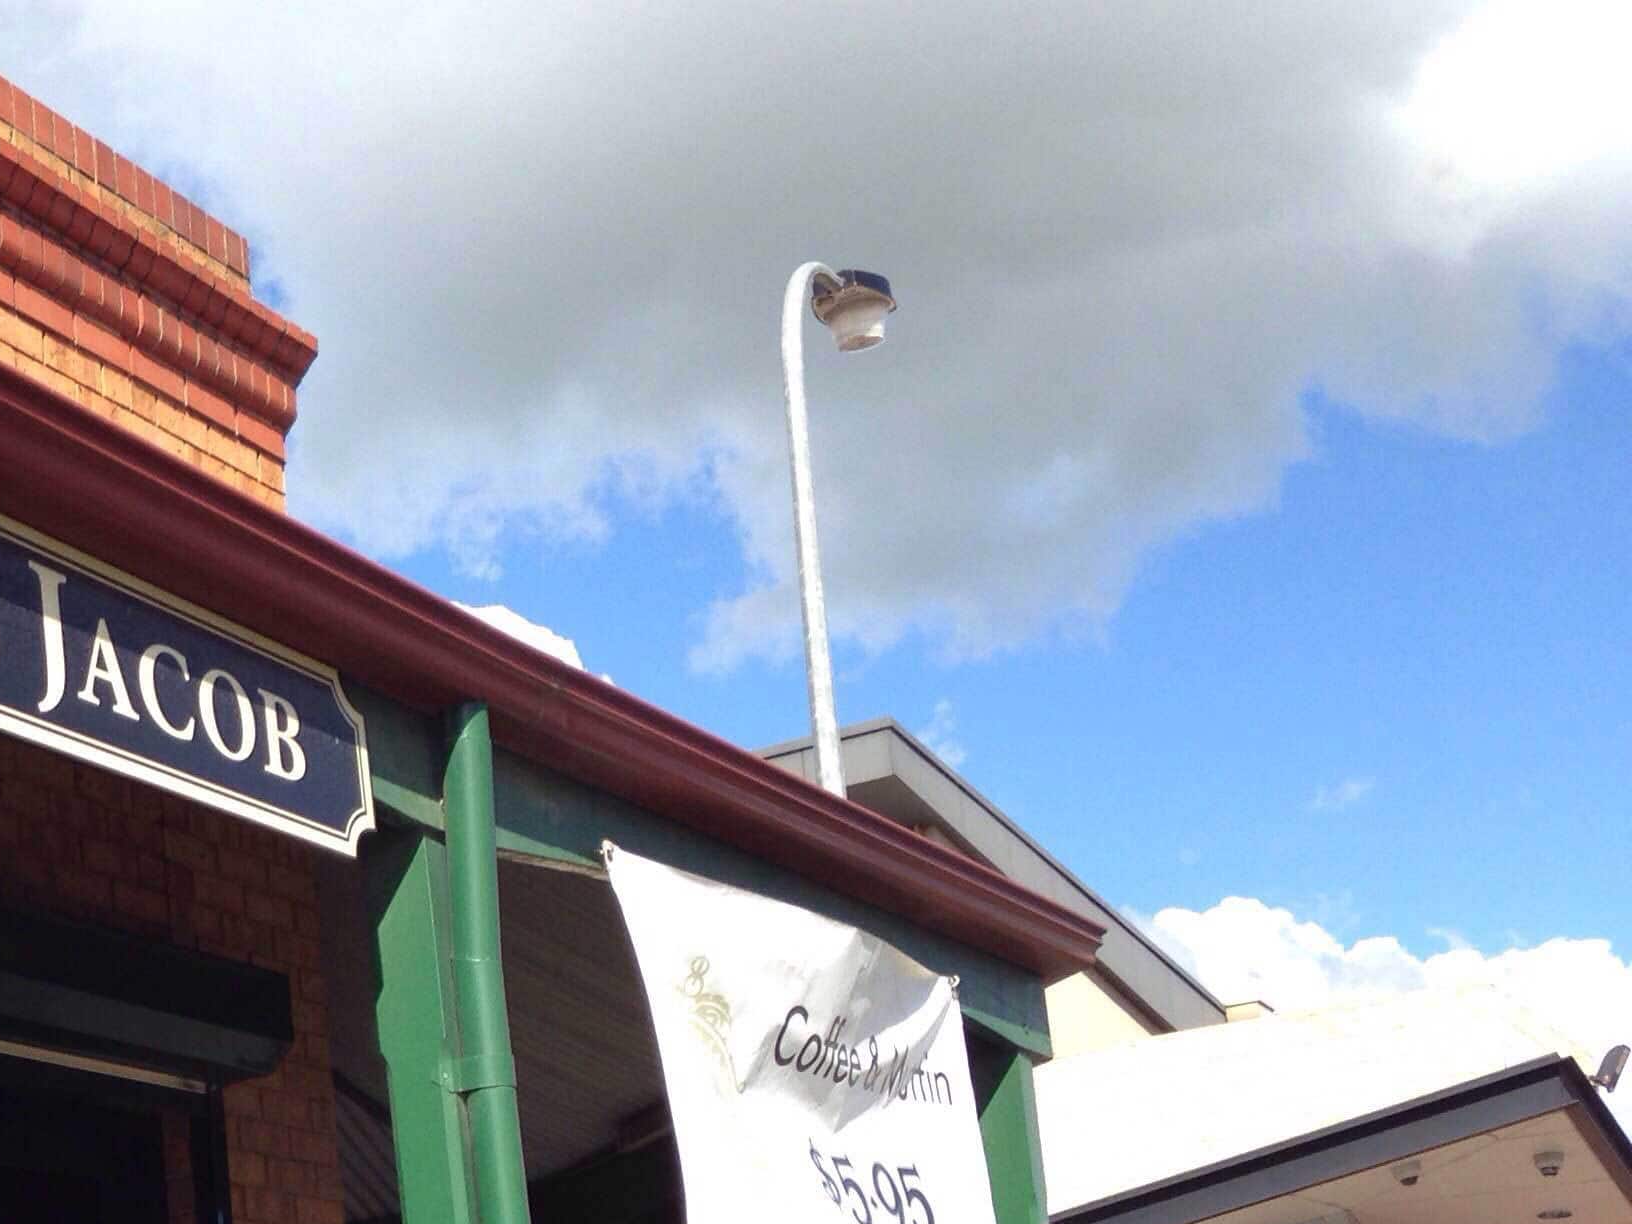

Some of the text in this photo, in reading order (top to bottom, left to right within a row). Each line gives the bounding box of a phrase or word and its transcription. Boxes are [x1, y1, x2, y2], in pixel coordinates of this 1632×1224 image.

[28, 559, 307, 782] JACOB
[774, 1005, 862, 1088] Coffee
[864, 1034, 881, 1092] &
